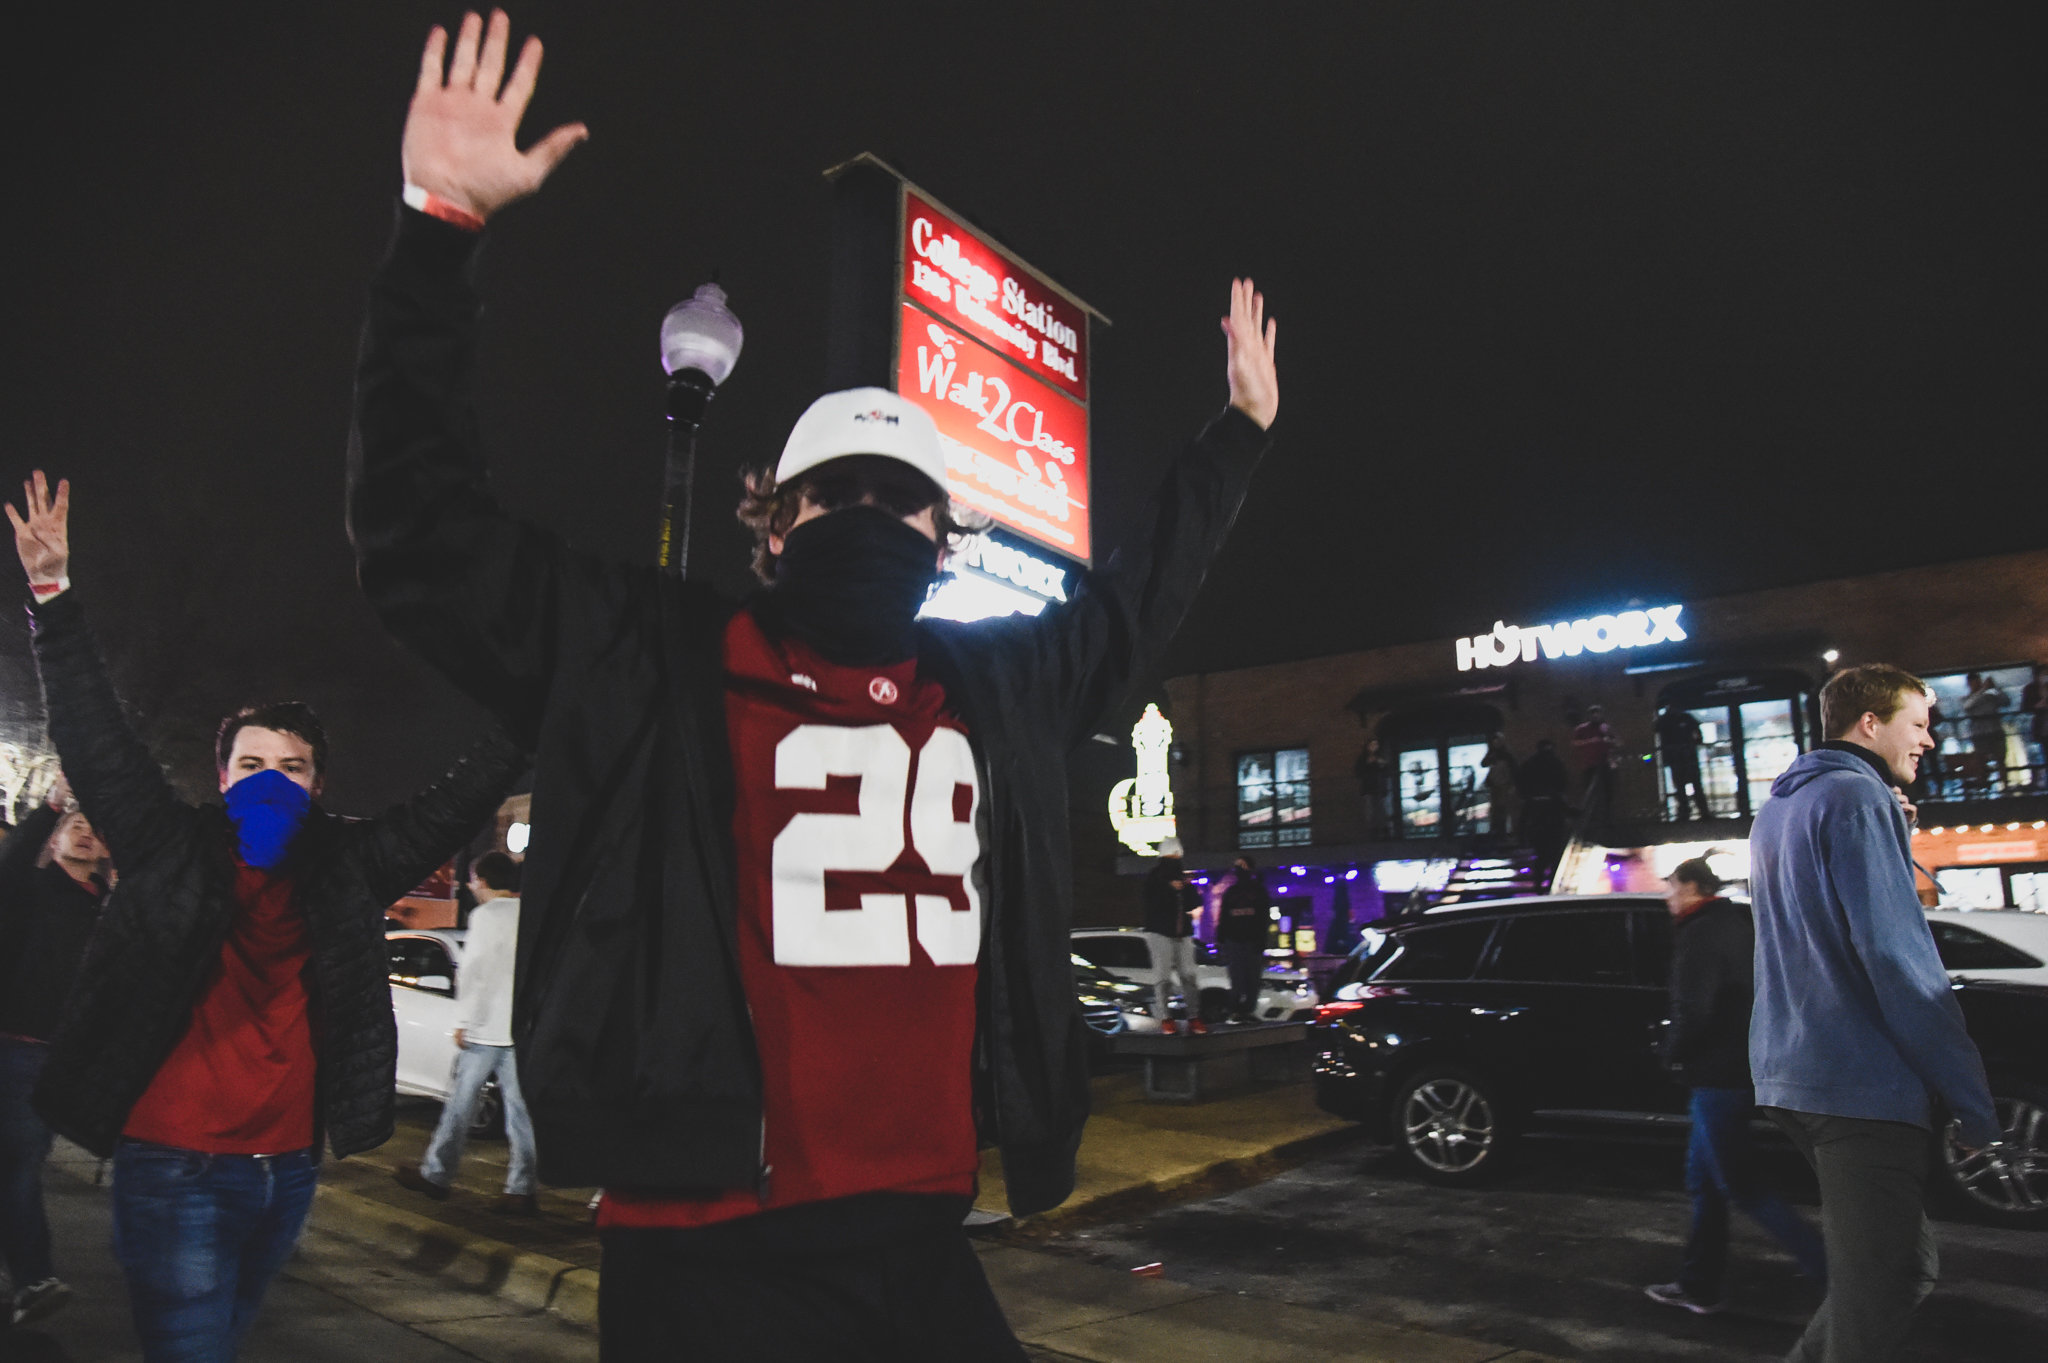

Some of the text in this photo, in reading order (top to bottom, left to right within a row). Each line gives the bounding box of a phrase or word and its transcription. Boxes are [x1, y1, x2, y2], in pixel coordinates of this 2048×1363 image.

[912, 218, 1077, 354] College Station
[1456, 604, 1687, 672] HOTWORX
[771, 723, 981, 967] 29
